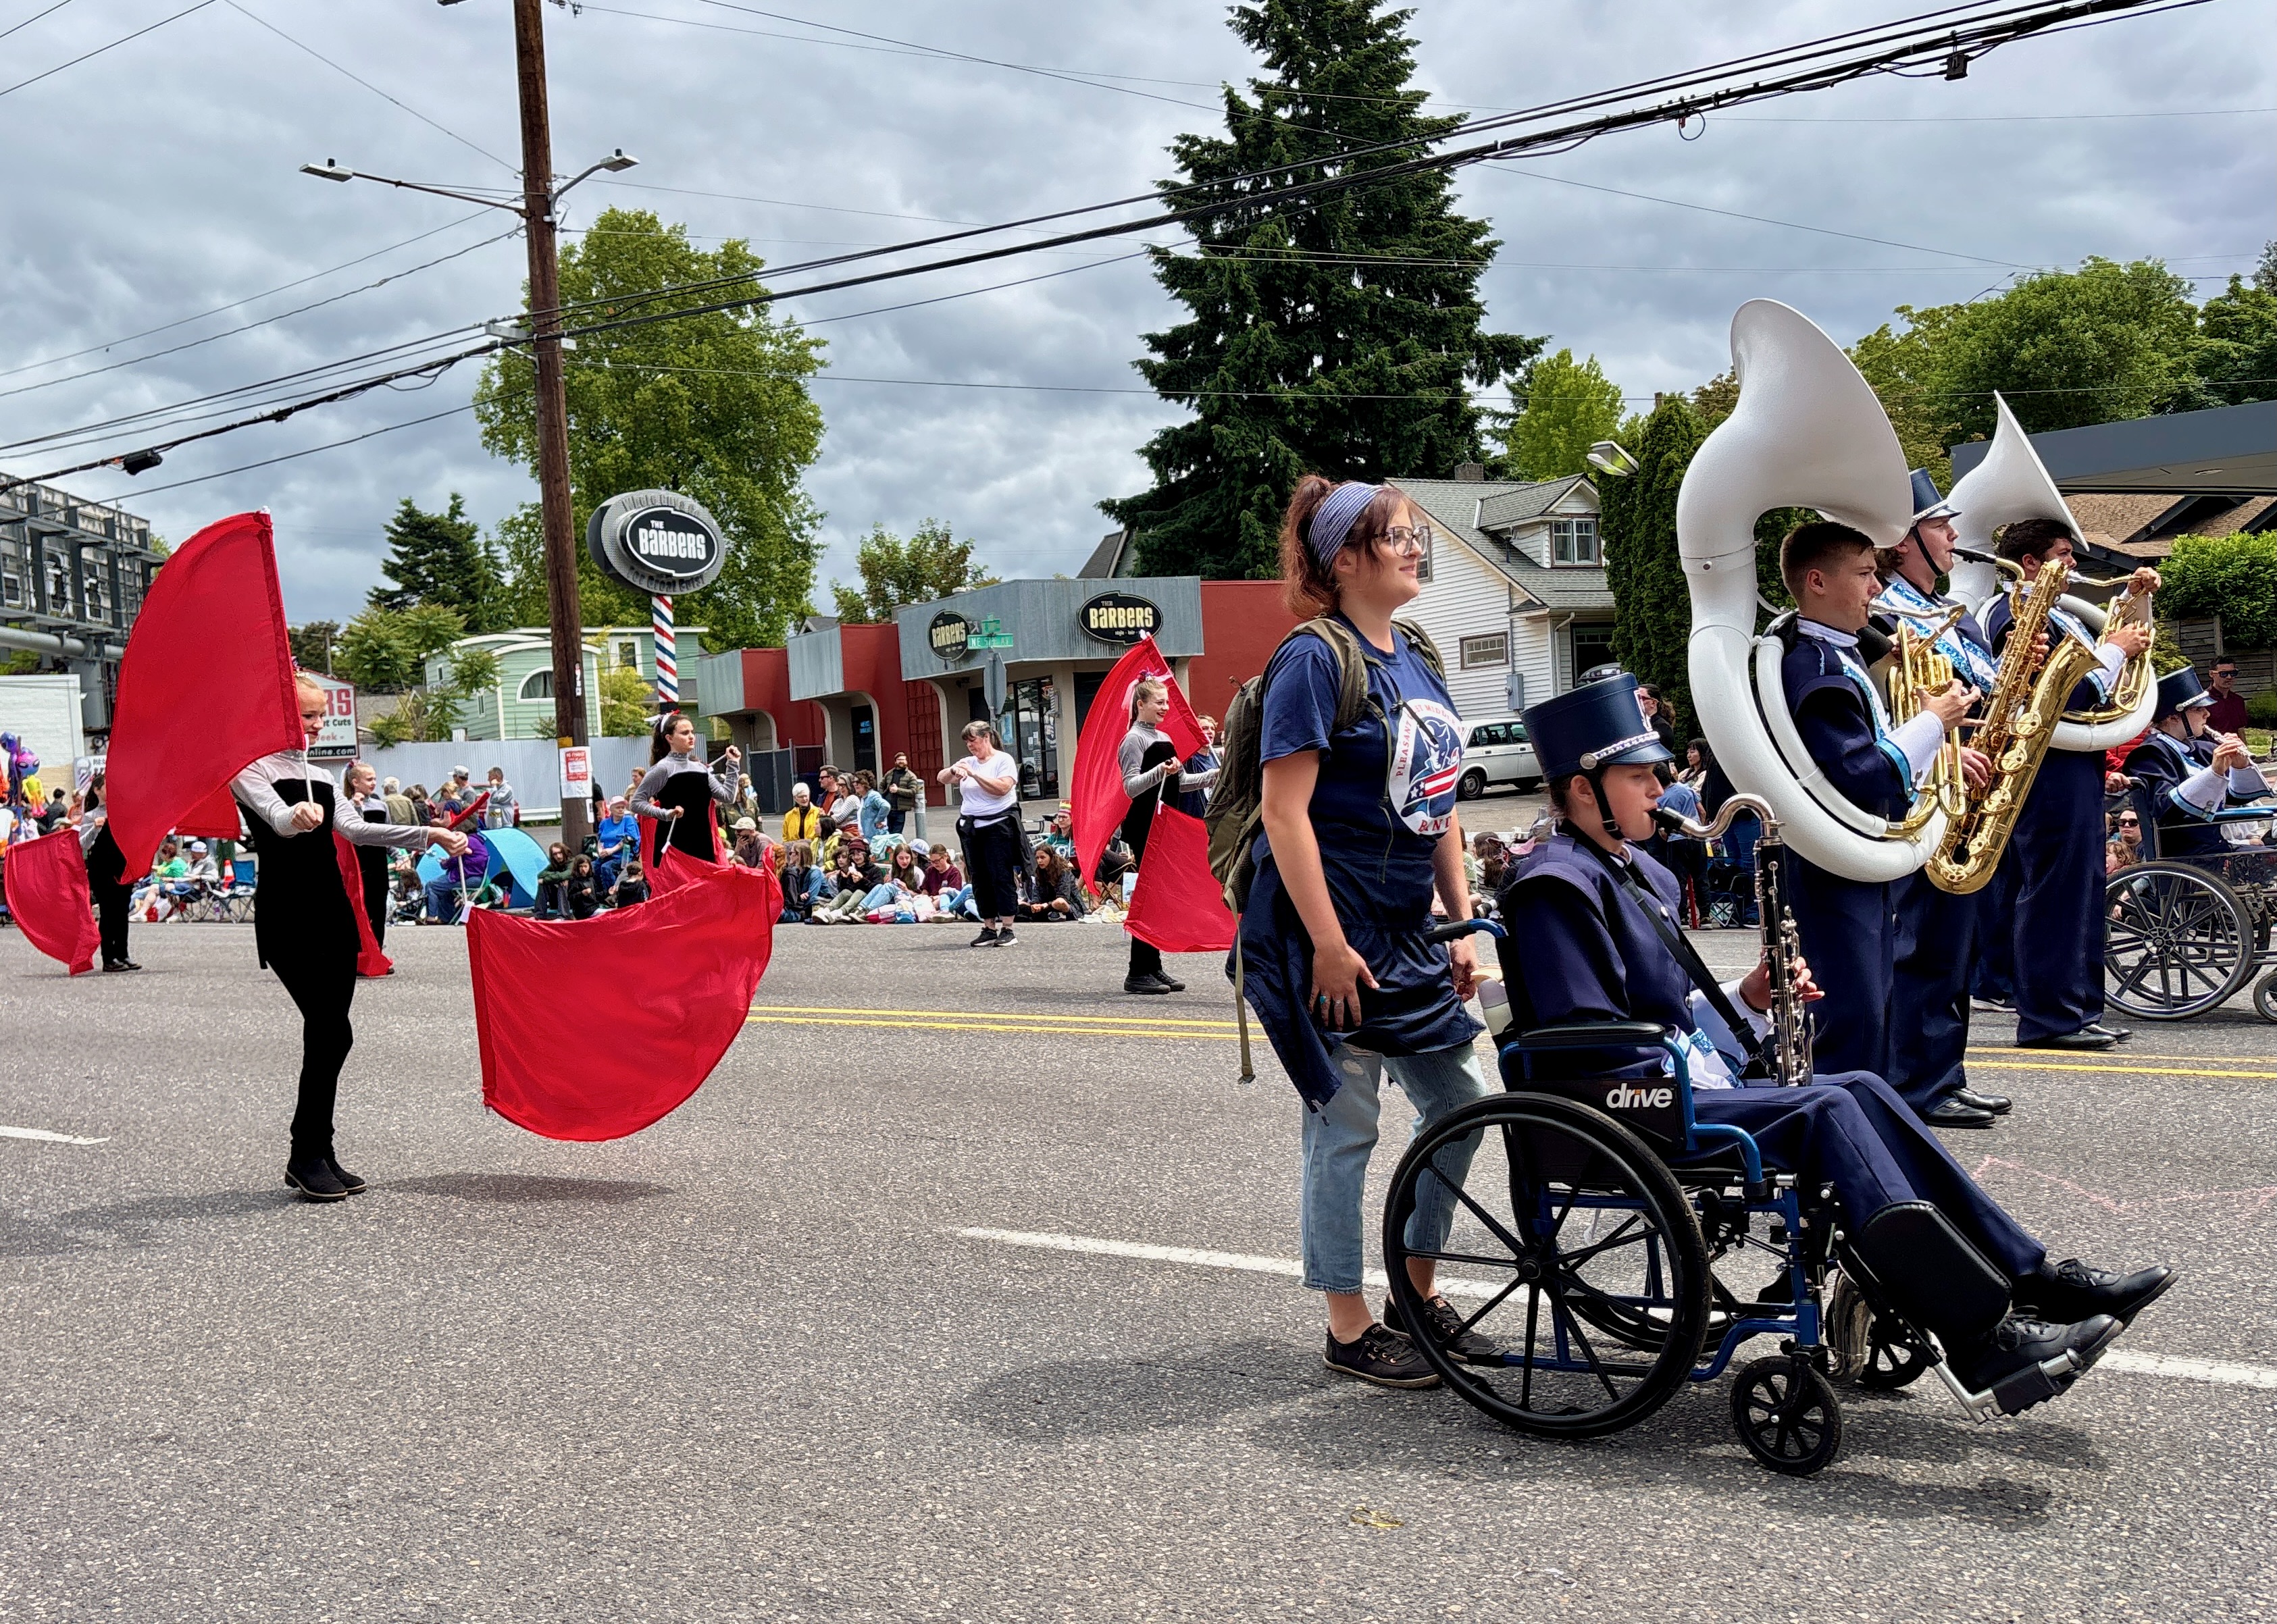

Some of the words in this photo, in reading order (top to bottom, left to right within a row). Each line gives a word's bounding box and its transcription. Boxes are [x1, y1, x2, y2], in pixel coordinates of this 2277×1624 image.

[650, 520, 665, 529] THE
[971, 637, 981, 647] NE
[332, 718, 351, 727] Cuts
[309, 748, 355, 756] nline.com
[1606, 1082, 1673, 1109] drive
